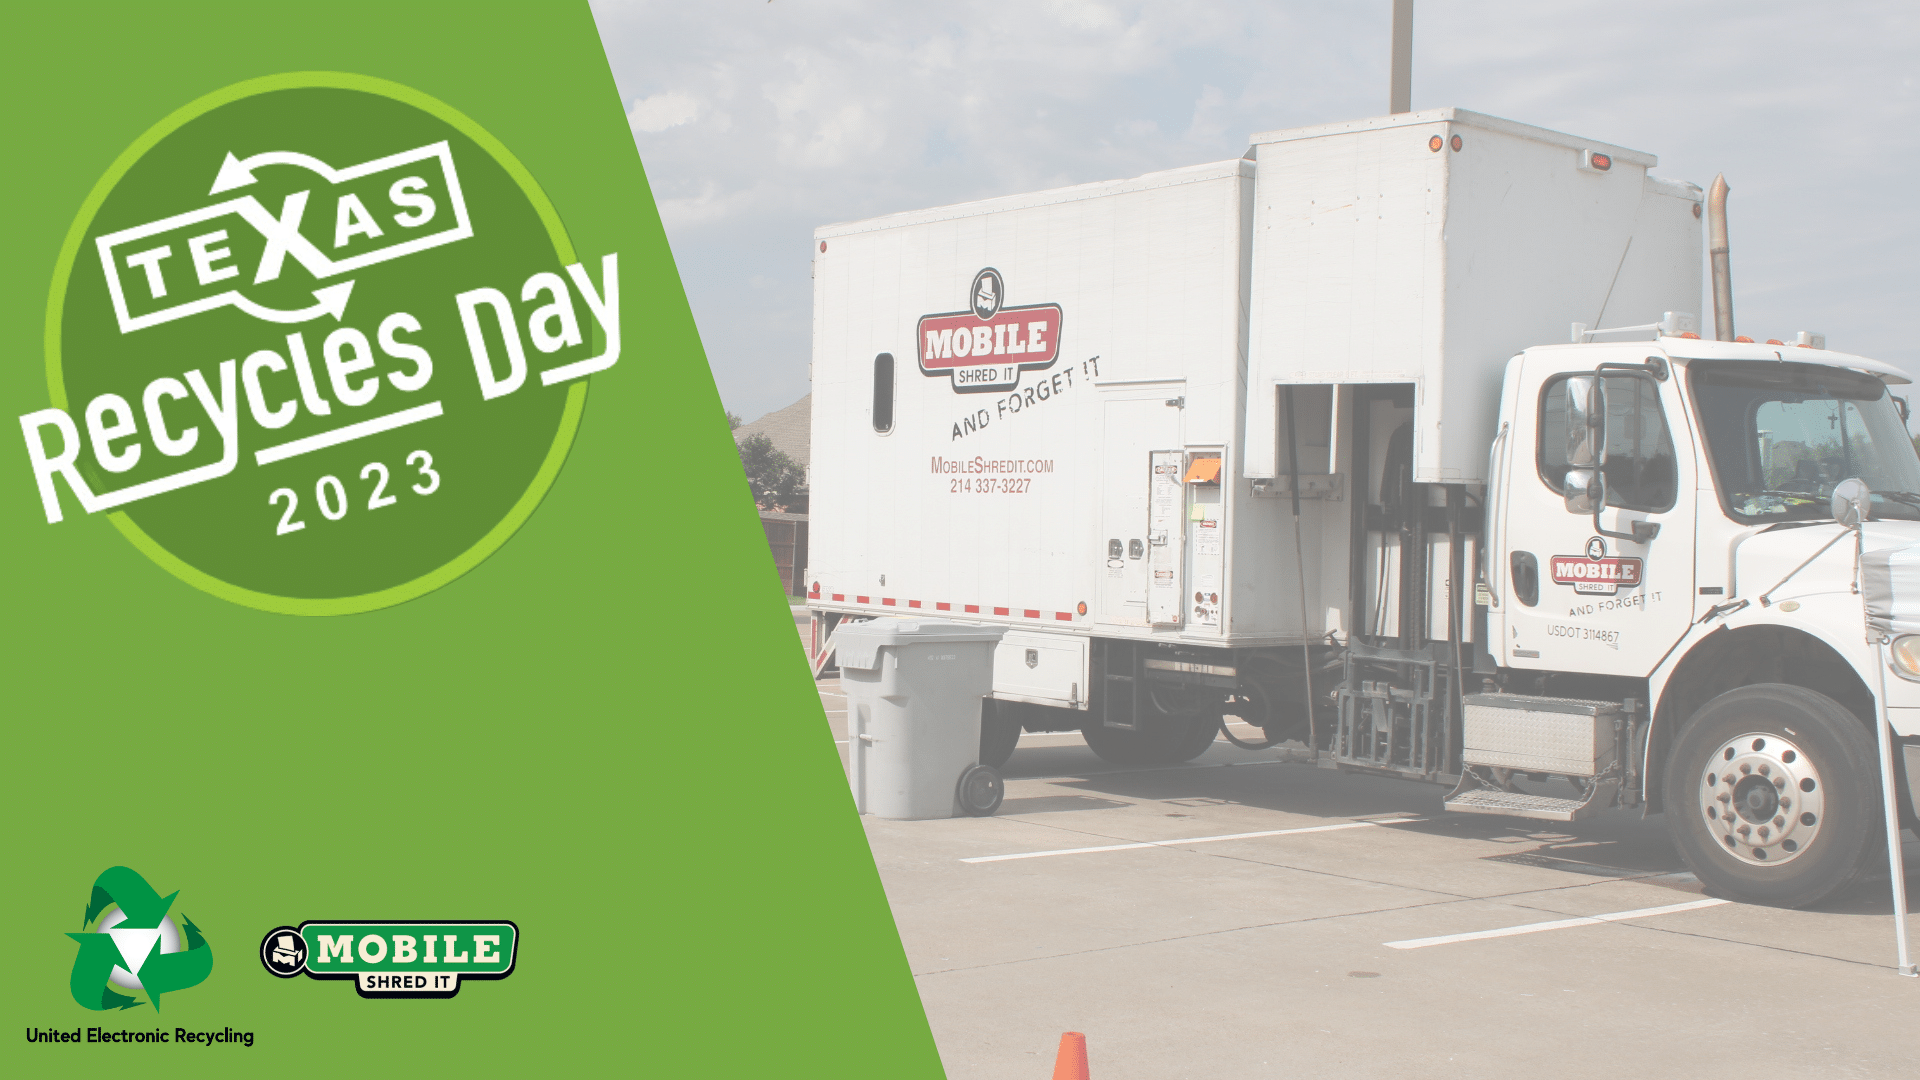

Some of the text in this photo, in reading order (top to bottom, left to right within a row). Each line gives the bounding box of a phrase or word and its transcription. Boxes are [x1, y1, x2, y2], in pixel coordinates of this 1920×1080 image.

[925, 321, 1048, 360] MOBILE
[959, 367, 1013, 383] SHRED IT
[952, 409, 990, 442] AND
[997, 367, 1073, 420] FORGET
[950, 478, 1031, 493] 214 337-3227
[1556, 563, 1634, 580] MOBILE
[1578, 583, 1603, 591] SHRED
[1569, 605, 1594, 617] AND
[1598, 594, 1645, 612] FORGET
[1547, 624, 1620, 643] USDOT 3114867
